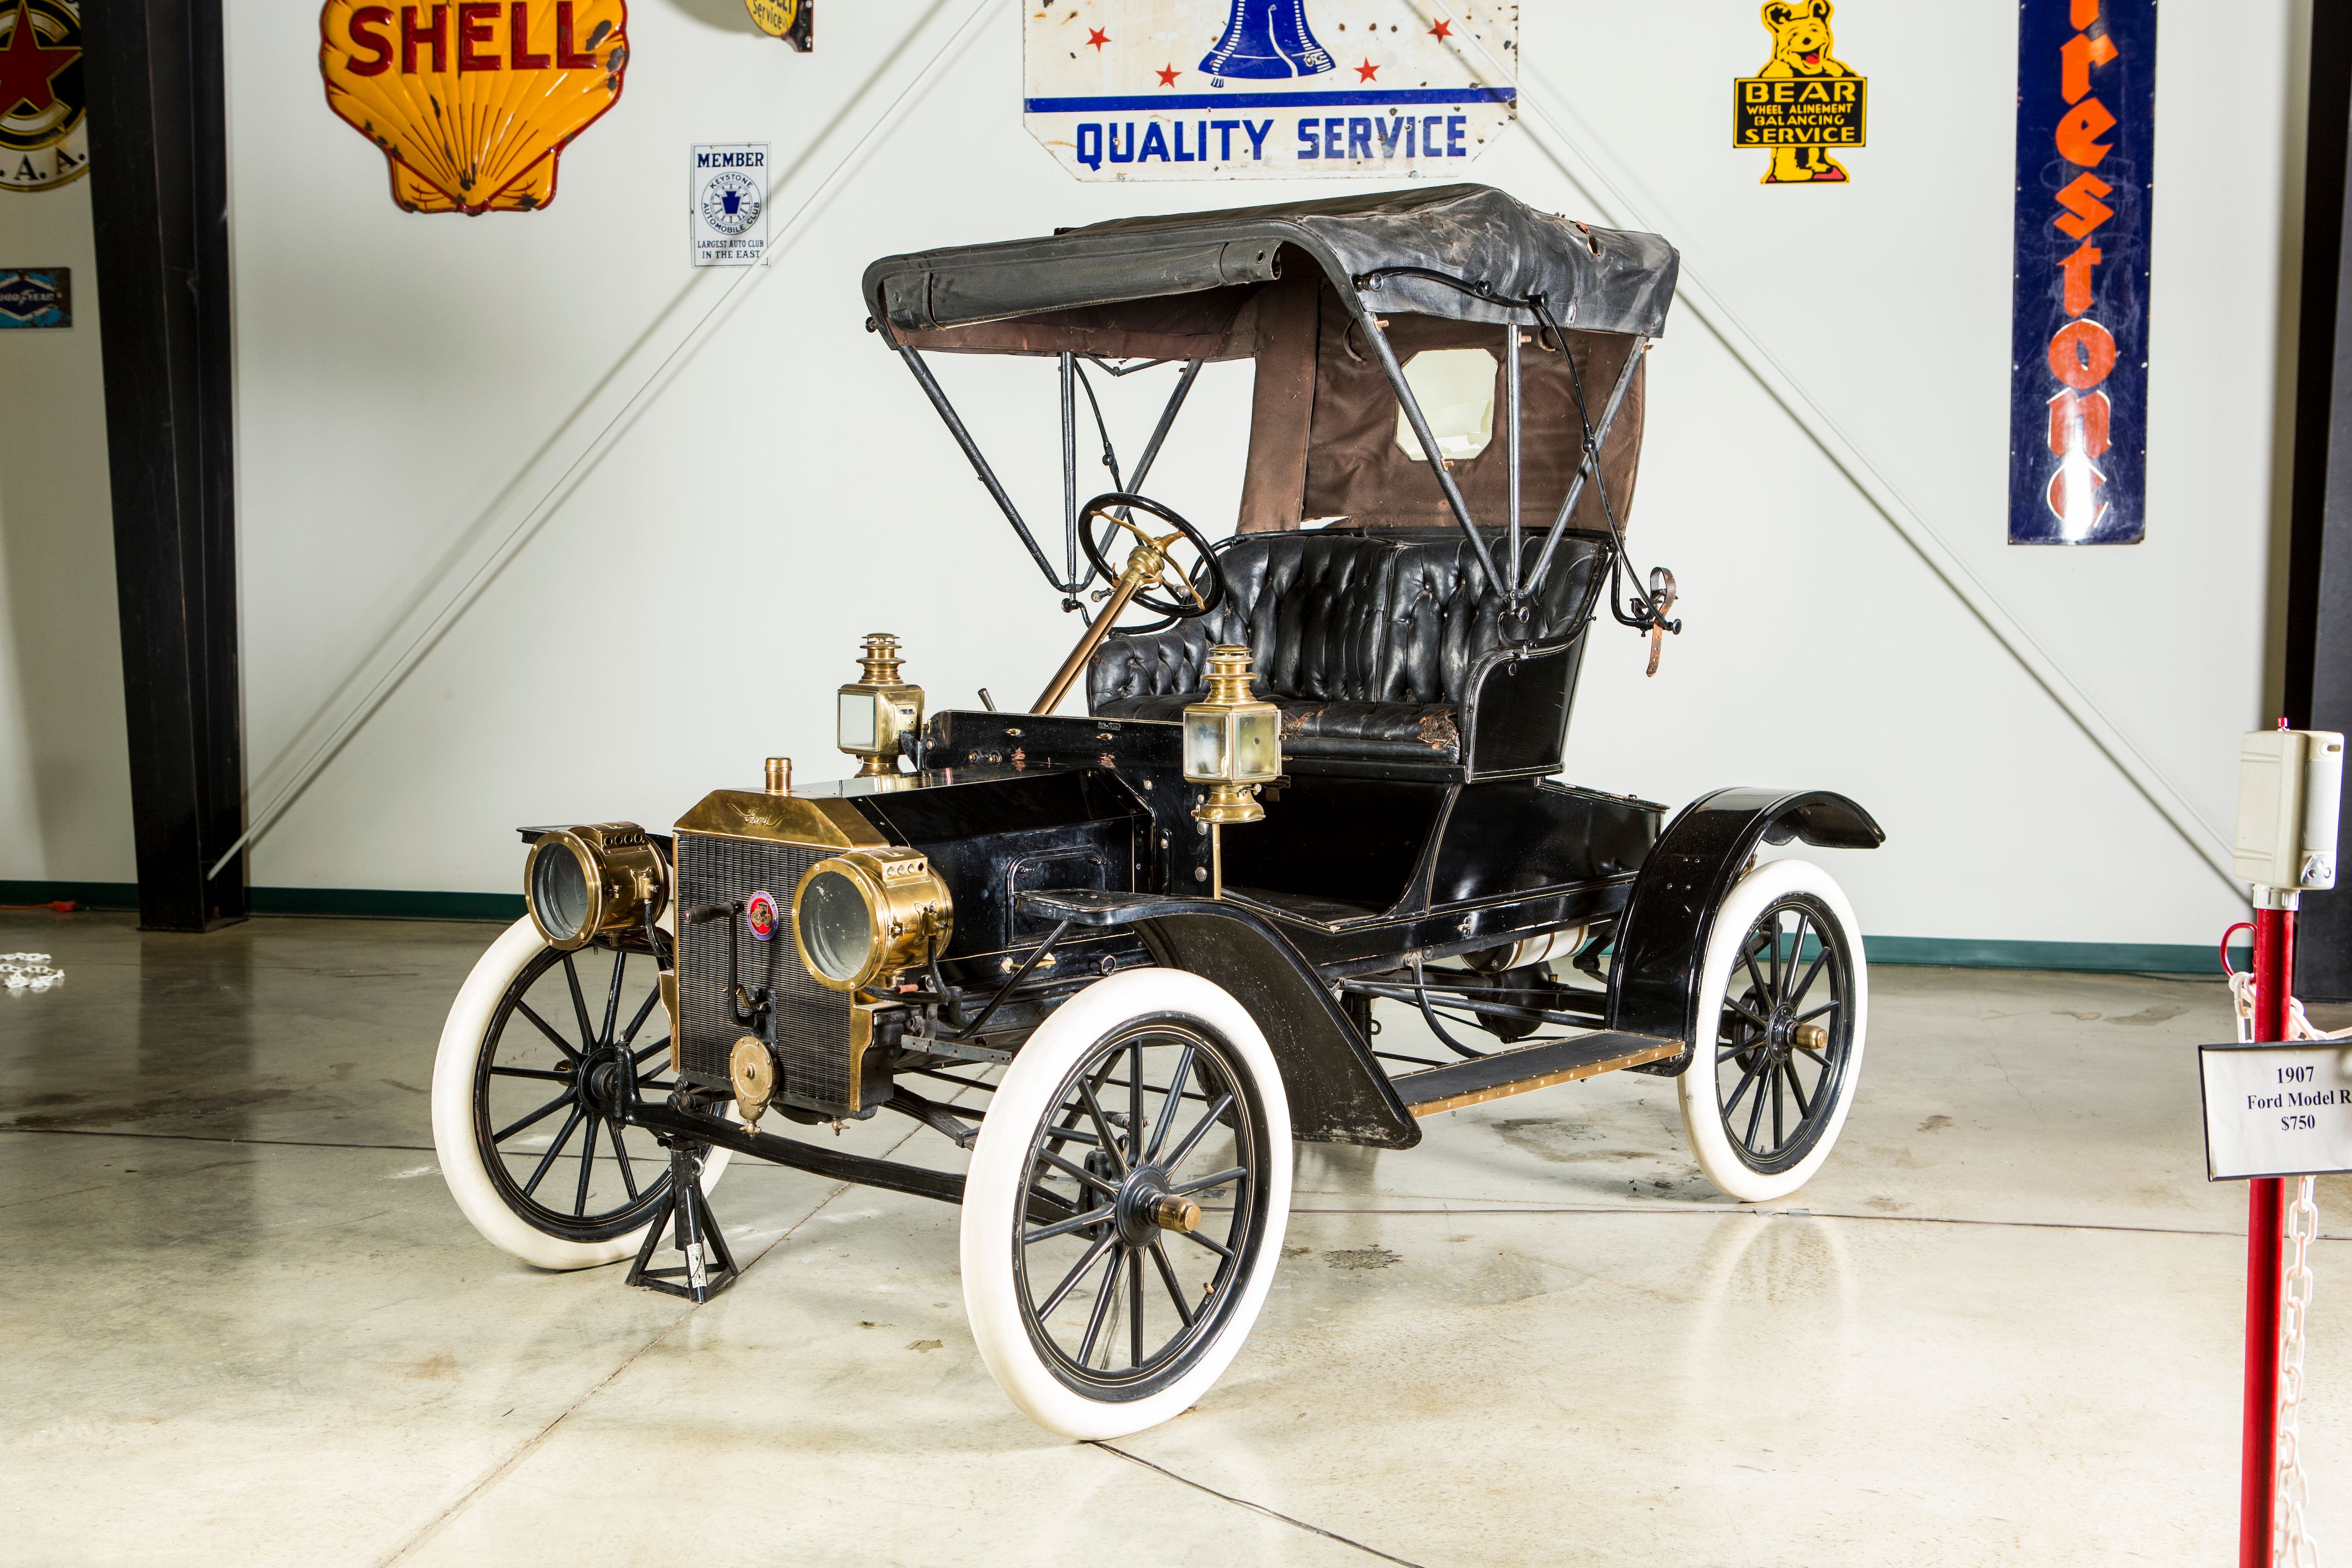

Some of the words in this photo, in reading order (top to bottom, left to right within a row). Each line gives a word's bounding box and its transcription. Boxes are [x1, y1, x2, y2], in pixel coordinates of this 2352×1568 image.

[753, 0, 782, 29] Service
[346, 1, 597, 76] SHELL
[1745, 82, 1855, 102] BEAR
[1746, 105, 1783, 115] WHEEL
[1789, 103, 1853, 114] ALINEMENT
[1754, 115, 1845, 126] BALANCING
[1077, 119, 1275, 171] QUALITY
[1297, 115, 1466, 160] SERVICE
[1745, 127, 1855, 143] SERVICE
[697, 152, 764, 168] MEMBER
[709, 174, 753, 189] KEYSTONE
[703, 203, 745, 233] AUTOMOBILE
[747, 202, 760, 224] CLUB
[697, 240, 727, 248] LARGEST
[715, 250, 733, 259] THE
[2277, 1066, 2314, 1083] 1907
[2247, 1094, 2282, 1109] Ford
[2288, 1090, 2335, 1106] Model
[2339, 1089, 2352, 1104] R
[2281, 1114, 2315, 1131] $750
